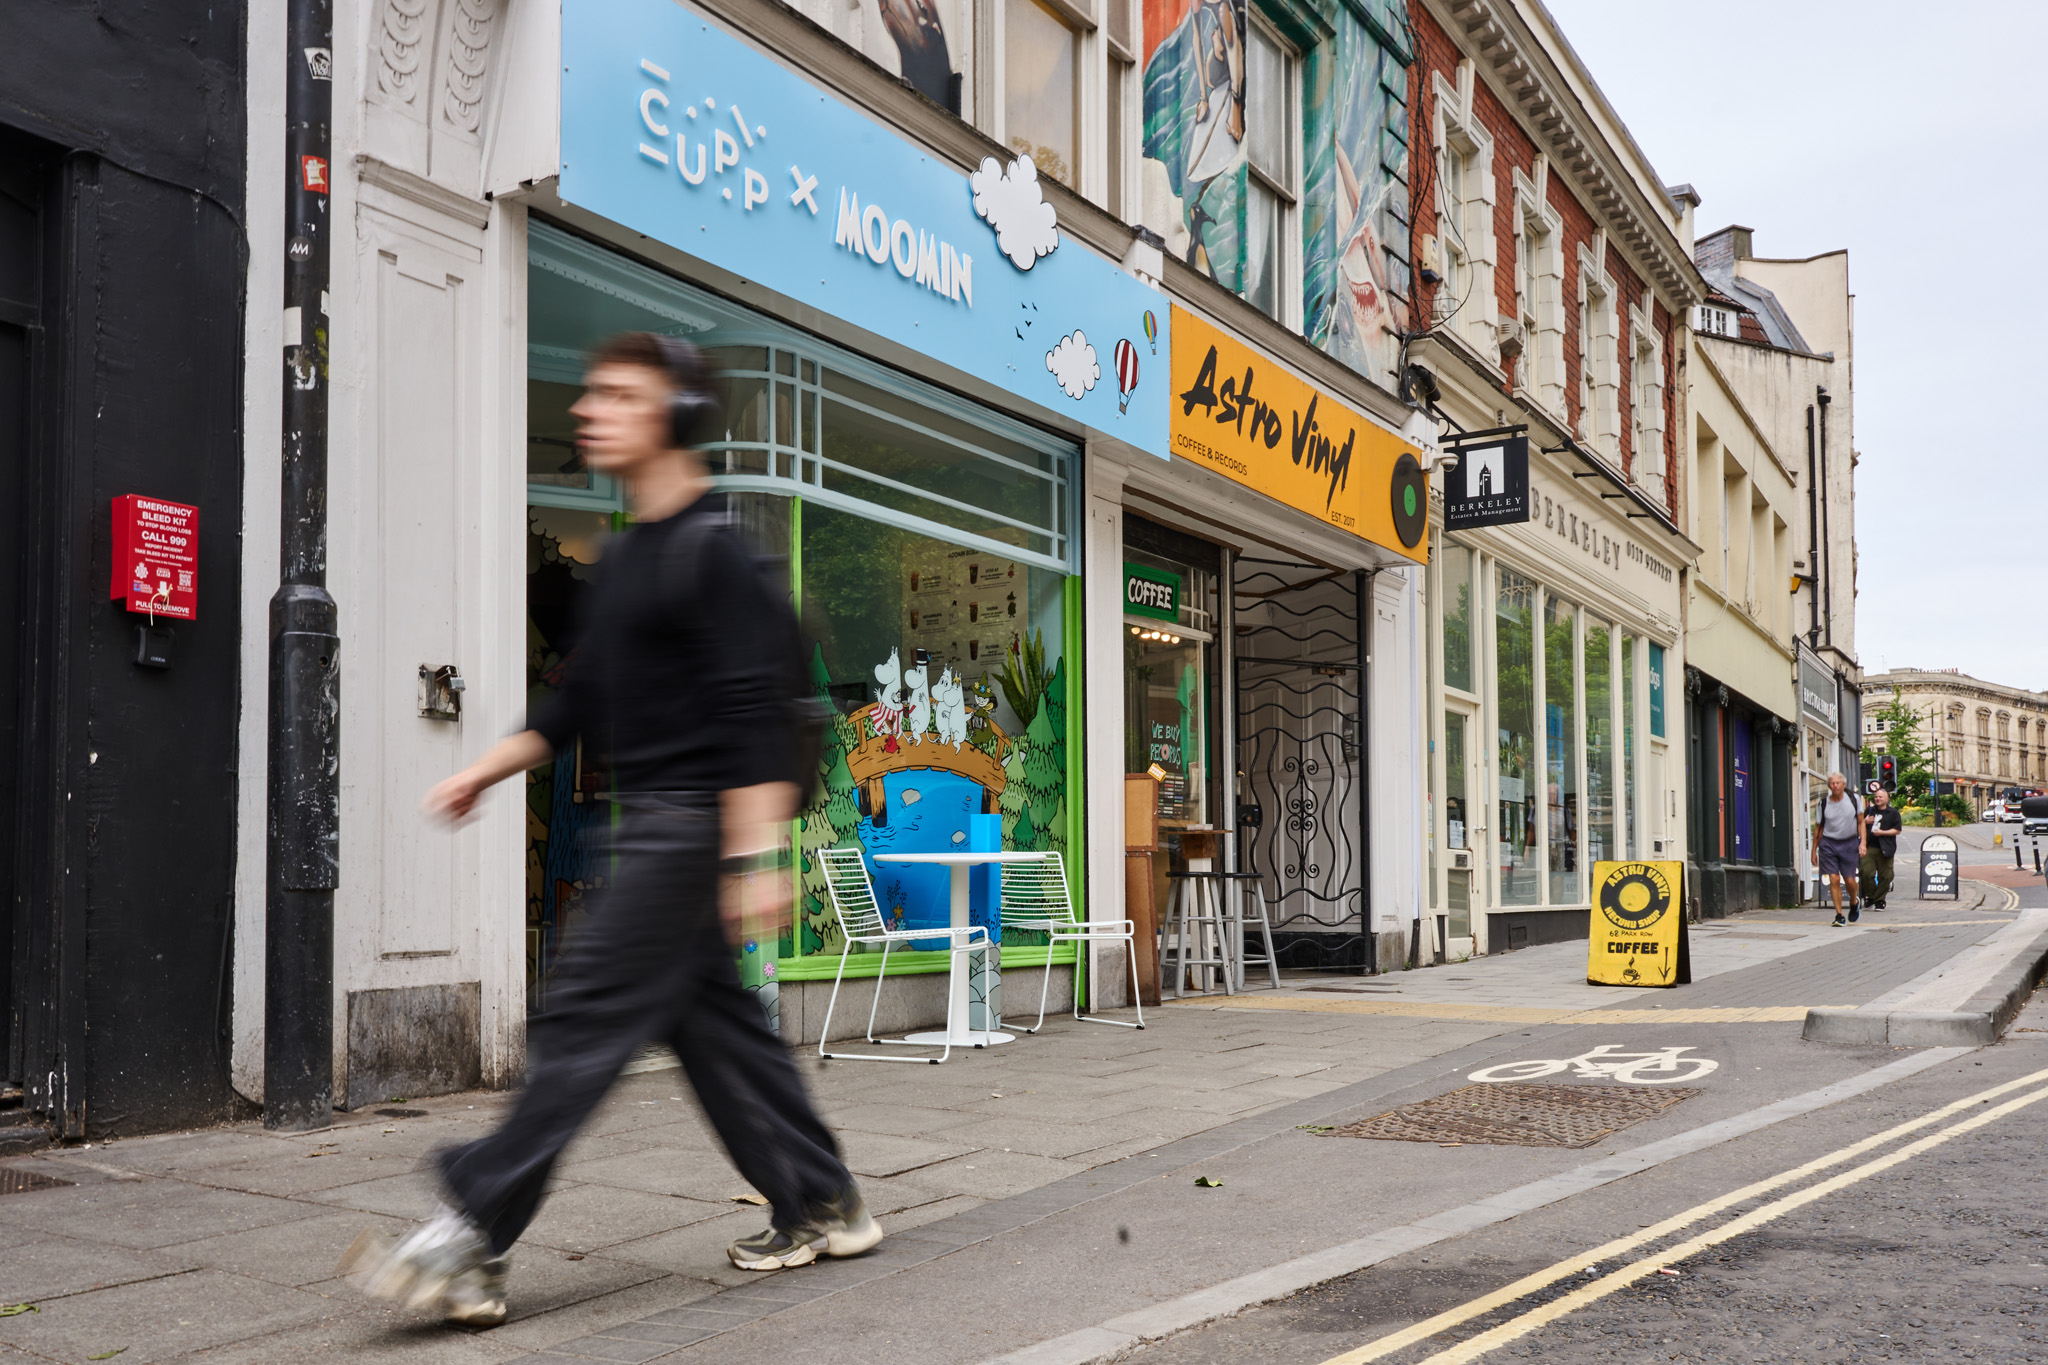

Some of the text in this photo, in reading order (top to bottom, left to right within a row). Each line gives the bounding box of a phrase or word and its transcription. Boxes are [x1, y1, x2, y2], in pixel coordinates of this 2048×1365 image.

[835, 185, 972, 309] MOOMIN
[1179, 344, 1356, 514] Astro Vinyl
[1177, 433, 1248, 476] COFFEE & RECORDS
[137, 499, 192, 518] EMERGENCY
[1450, 496, 1522, 513] BERKELEY
[1481, 507, 1522, 516] Management
[137, 519, 144, 527] TO
[145, 521, 159, 529] STOP
[159, 524, 177, 533] BLOOD
[142, 511, 187, 527] BLEED KIT
[1331, 510, 1343, 524] EST.
[1531, 486, 1620, 571] BERKELEY
[1626, 540, 1644, 564] 0117
[141, 530, 187, 547] CALL 999
[1127, 577, 1173, 610] COFFEE
[1151, 720, 1181, 743] WE BUY
[1150, 743, 1182, 766] RECORDS
[1645, 868, 1670, 900] VINYL
[1927, 884, 1949, 892] SHOP
[1607, 942, 1659, 955] COFFEE
